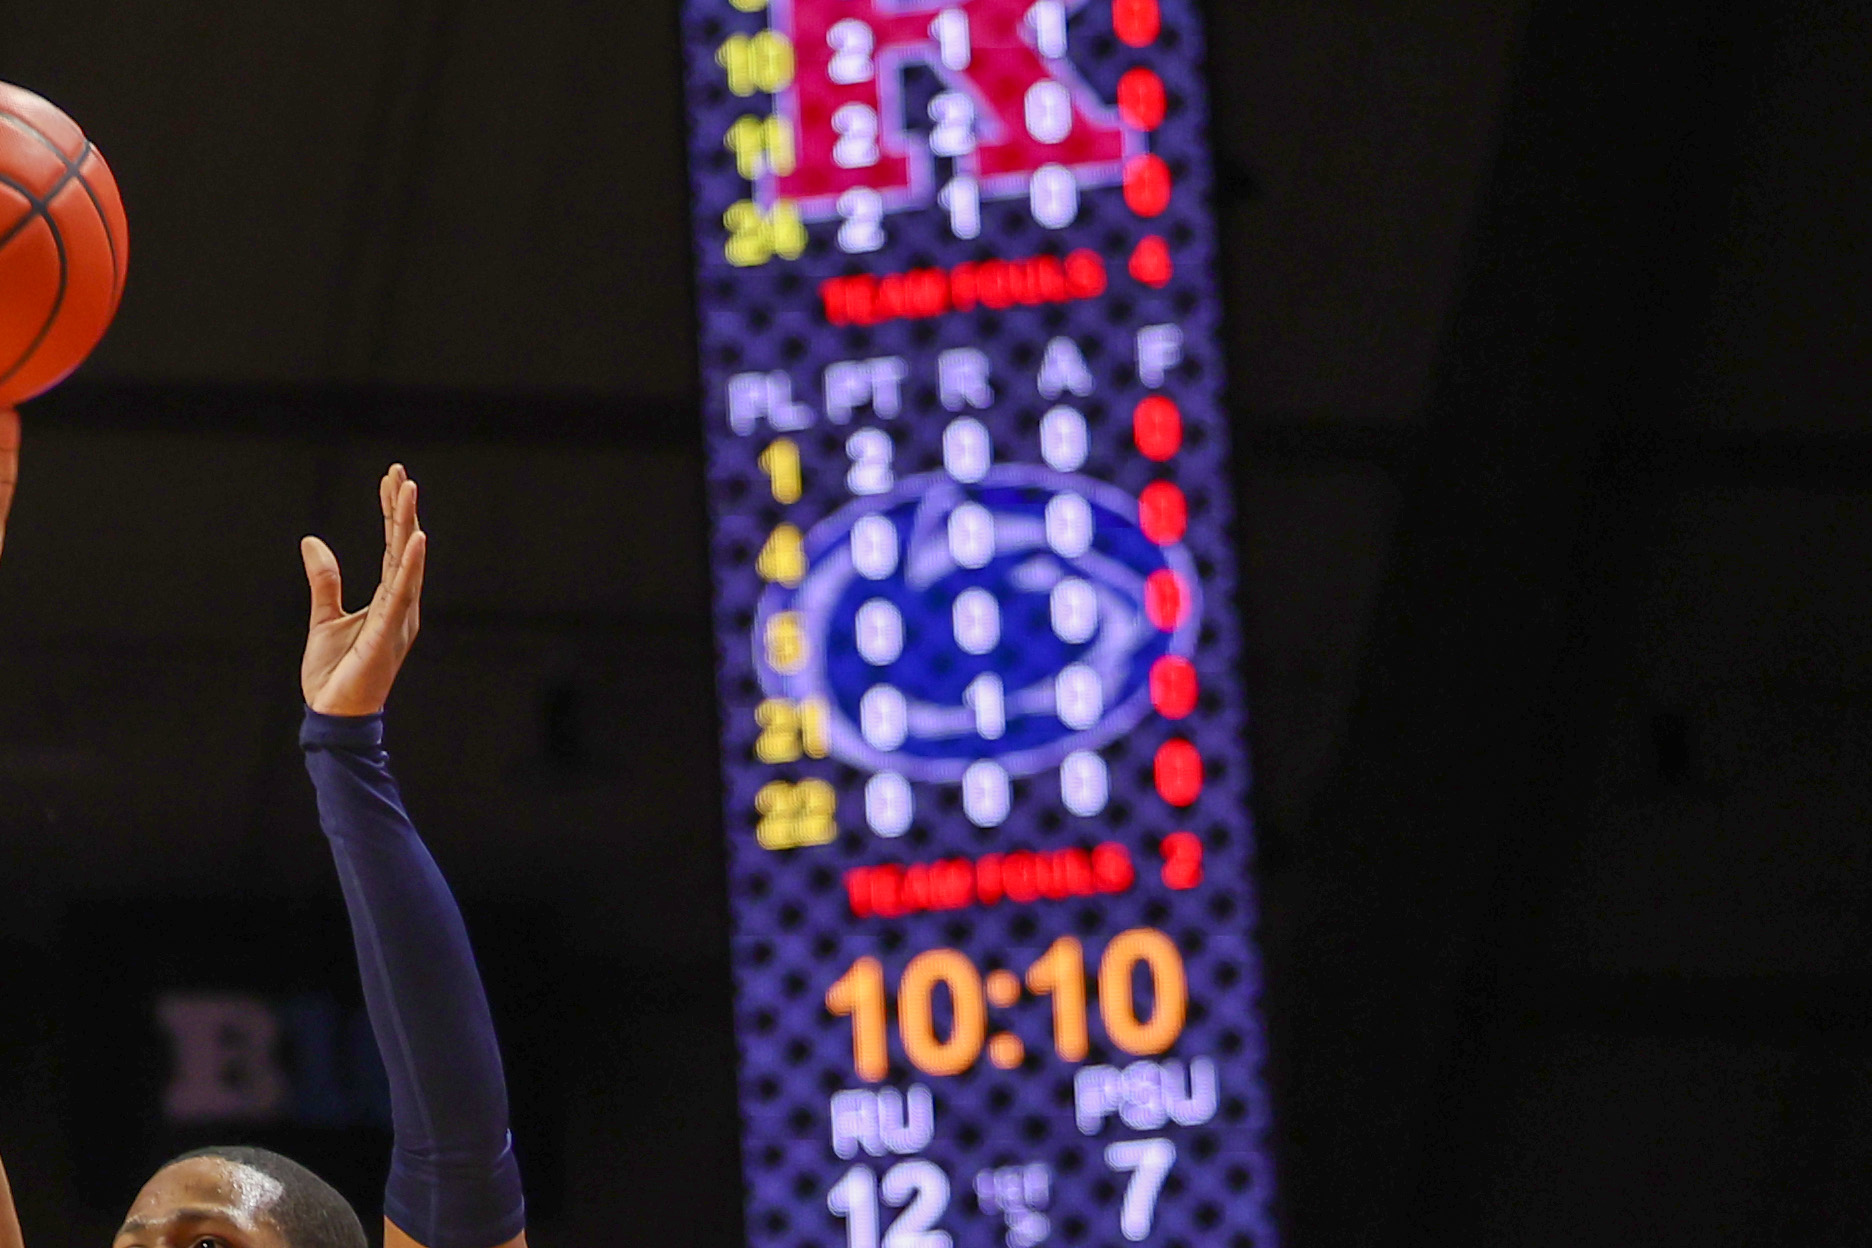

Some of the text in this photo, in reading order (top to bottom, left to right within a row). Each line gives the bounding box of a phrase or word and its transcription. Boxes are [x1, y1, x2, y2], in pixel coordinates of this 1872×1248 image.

[825, 927, 1188, 1082] 10:10
[830, 1082, 935, 1160] RU
[1104, 1137, 1176, 1241] 7
